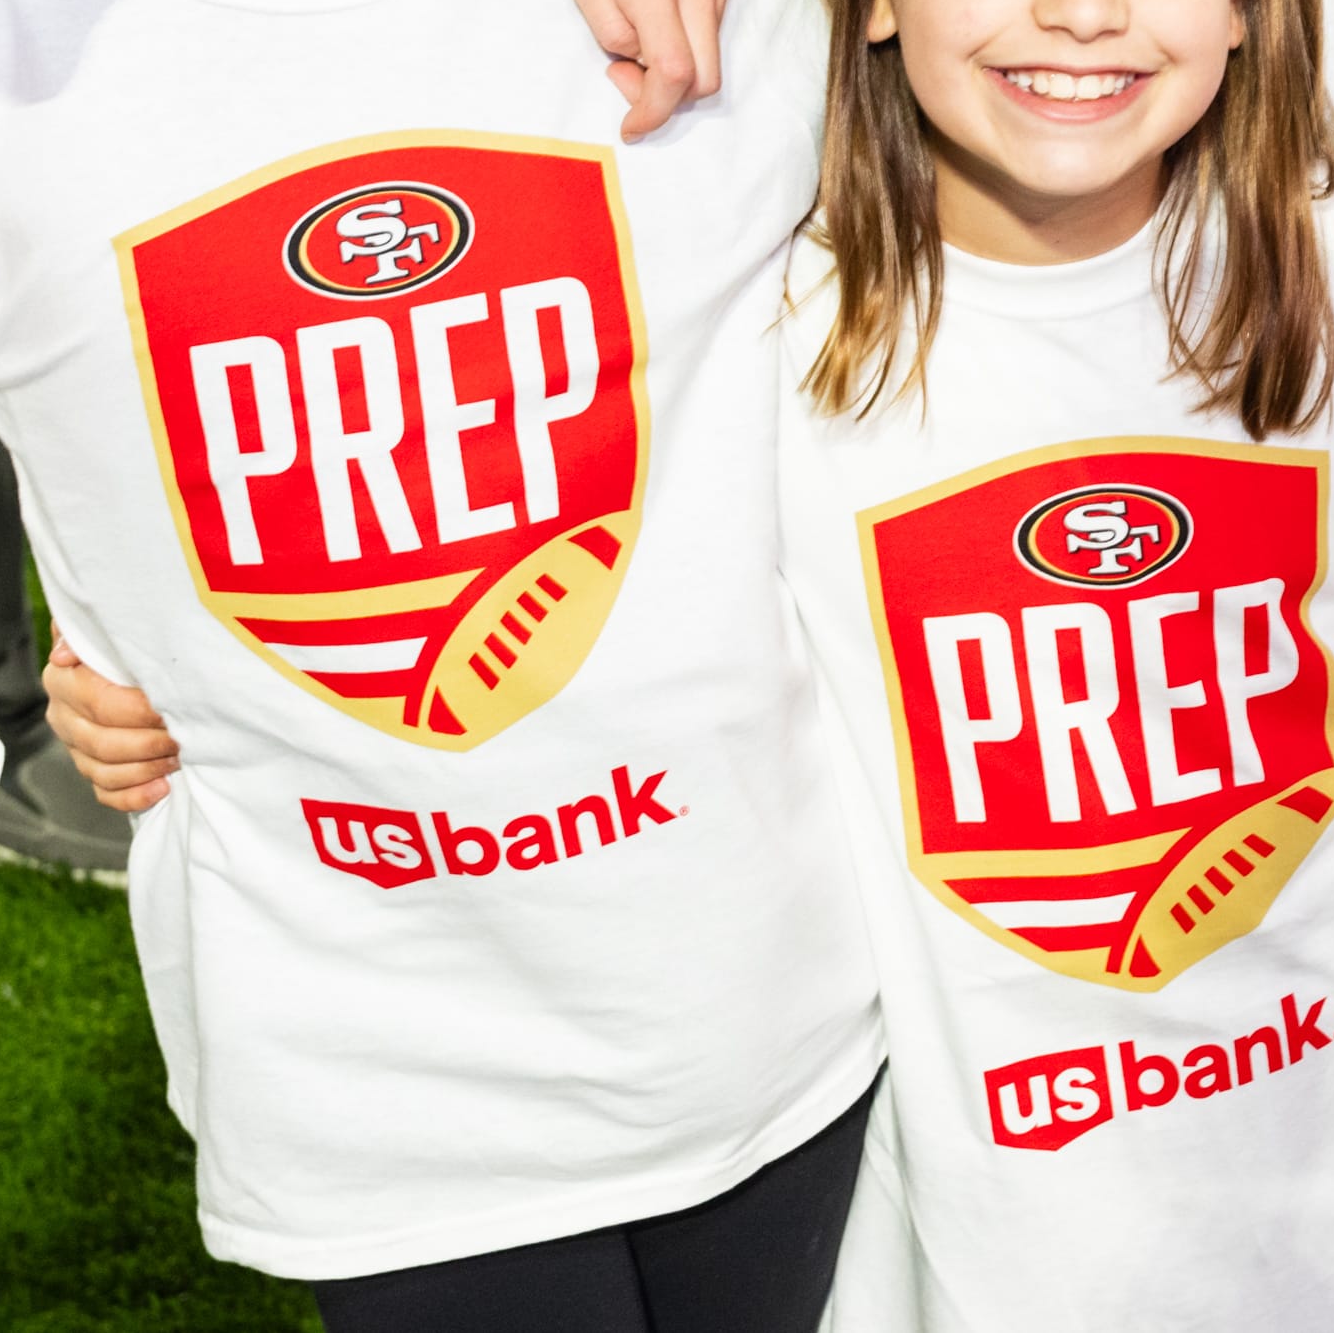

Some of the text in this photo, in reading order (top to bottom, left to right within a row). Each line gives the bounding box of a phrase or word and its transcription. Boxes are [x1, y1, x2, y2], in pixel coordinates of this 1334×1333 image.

[335, 198, 440, 285] SF
[188, 276, 600, 566] PREP
[1062, 499, 1161, 576] SF
[922, 577, 1300, 824] PREP
